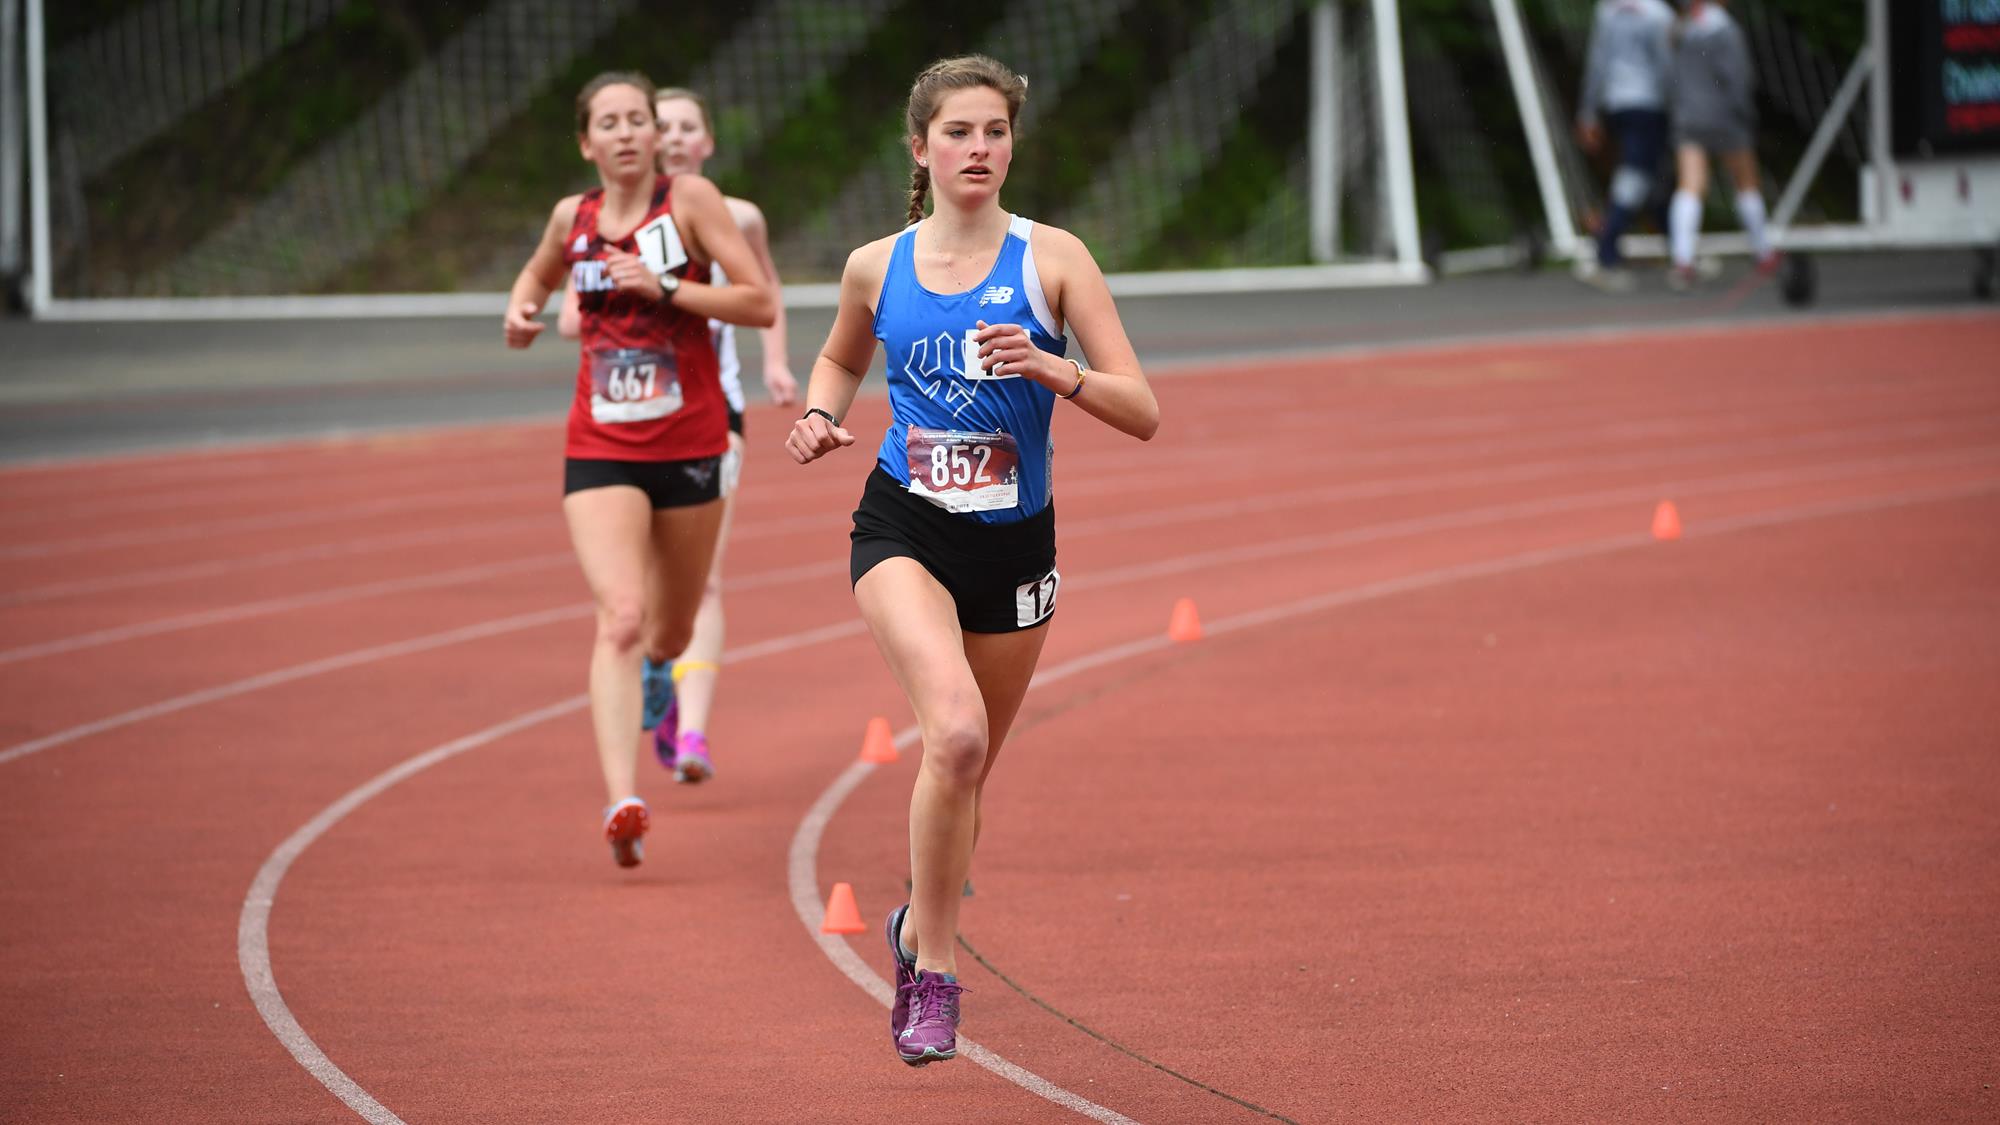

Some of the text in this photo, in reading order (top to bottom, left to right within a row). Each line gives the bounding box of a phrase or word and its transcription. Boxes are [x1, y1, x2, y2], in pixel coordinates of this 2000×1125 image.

[646, 223, 669, 265] 7
[608, 363, 657, 401] 667
[931, 445, 992, 487] 852
[1027, 573, 1057, 620] 12
